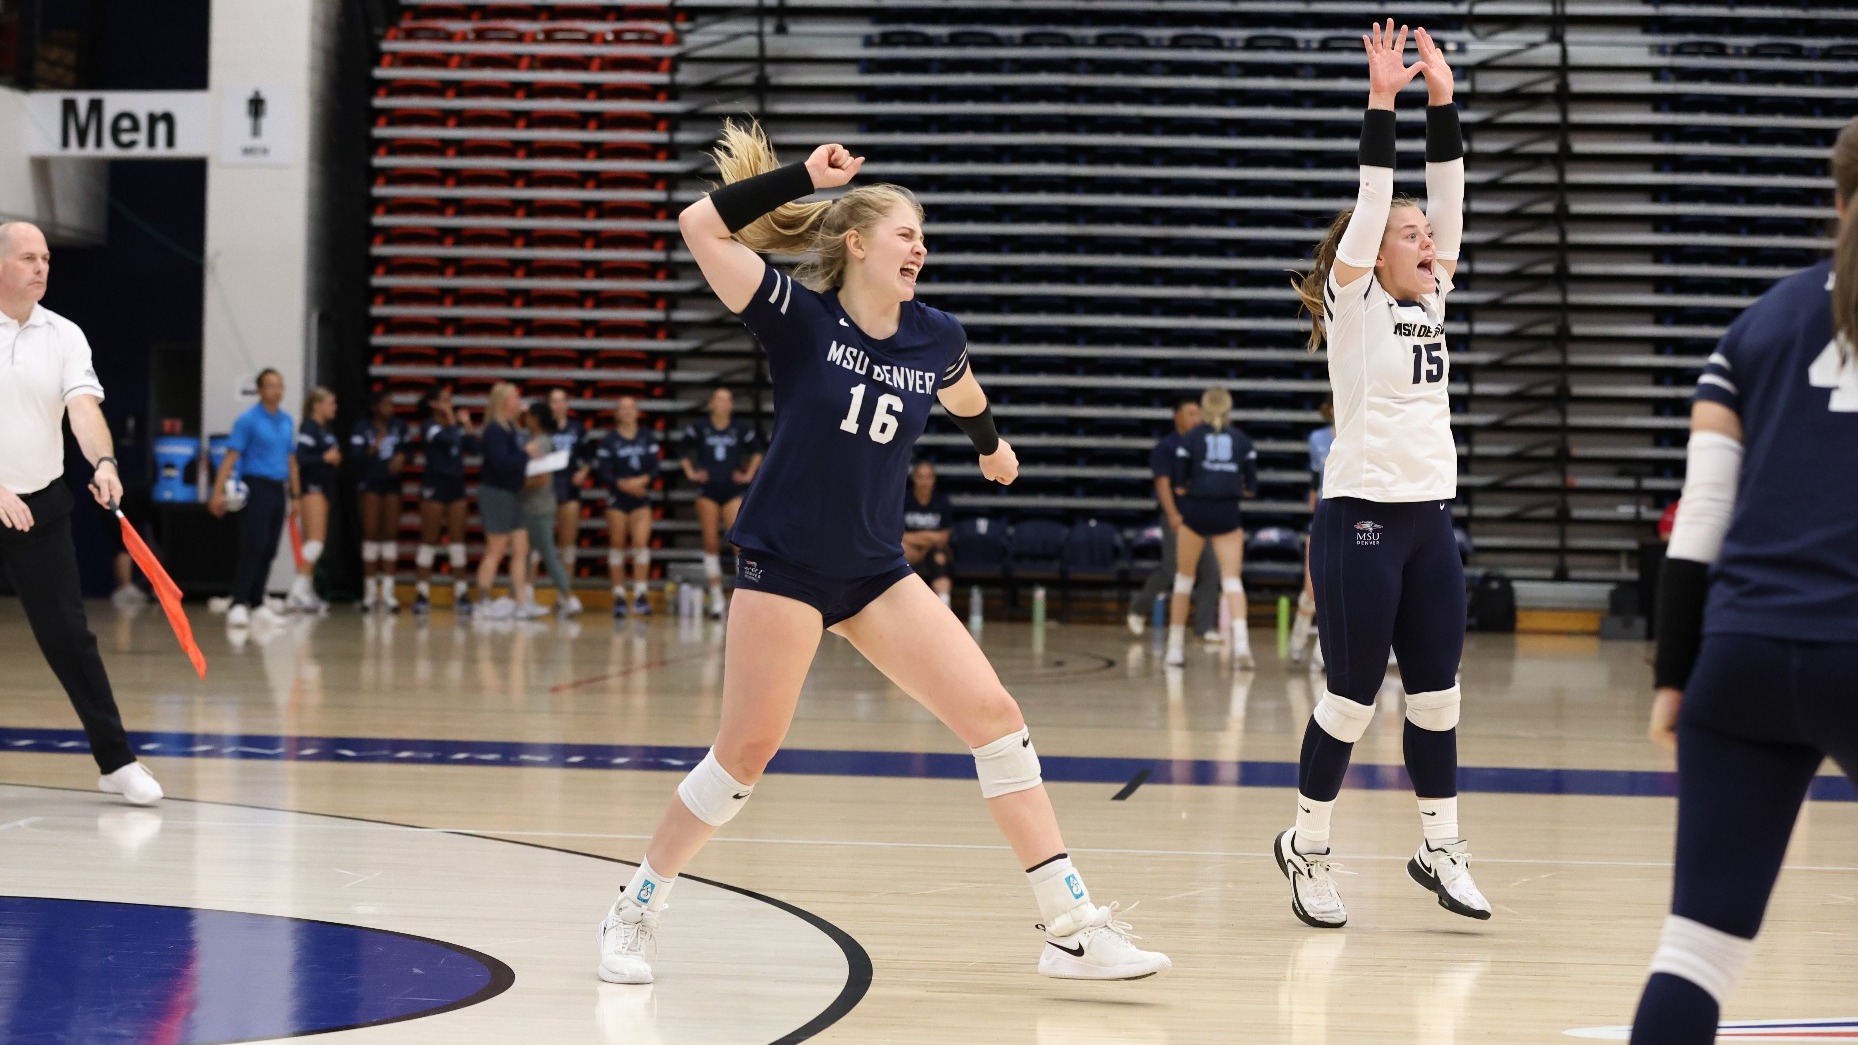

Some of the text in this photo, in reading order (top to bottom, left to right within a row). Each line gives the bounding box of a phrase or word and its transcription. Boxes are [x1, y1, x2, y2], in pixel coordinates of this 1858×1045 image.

[61, 98, 175, 149] Men
[827, 340, 935, 395] MSU DENVER
[1412, 343, 1444, 384] 15
[840, 383, 903, 444] 16
[1356, 532, 1380, 541] MSU
